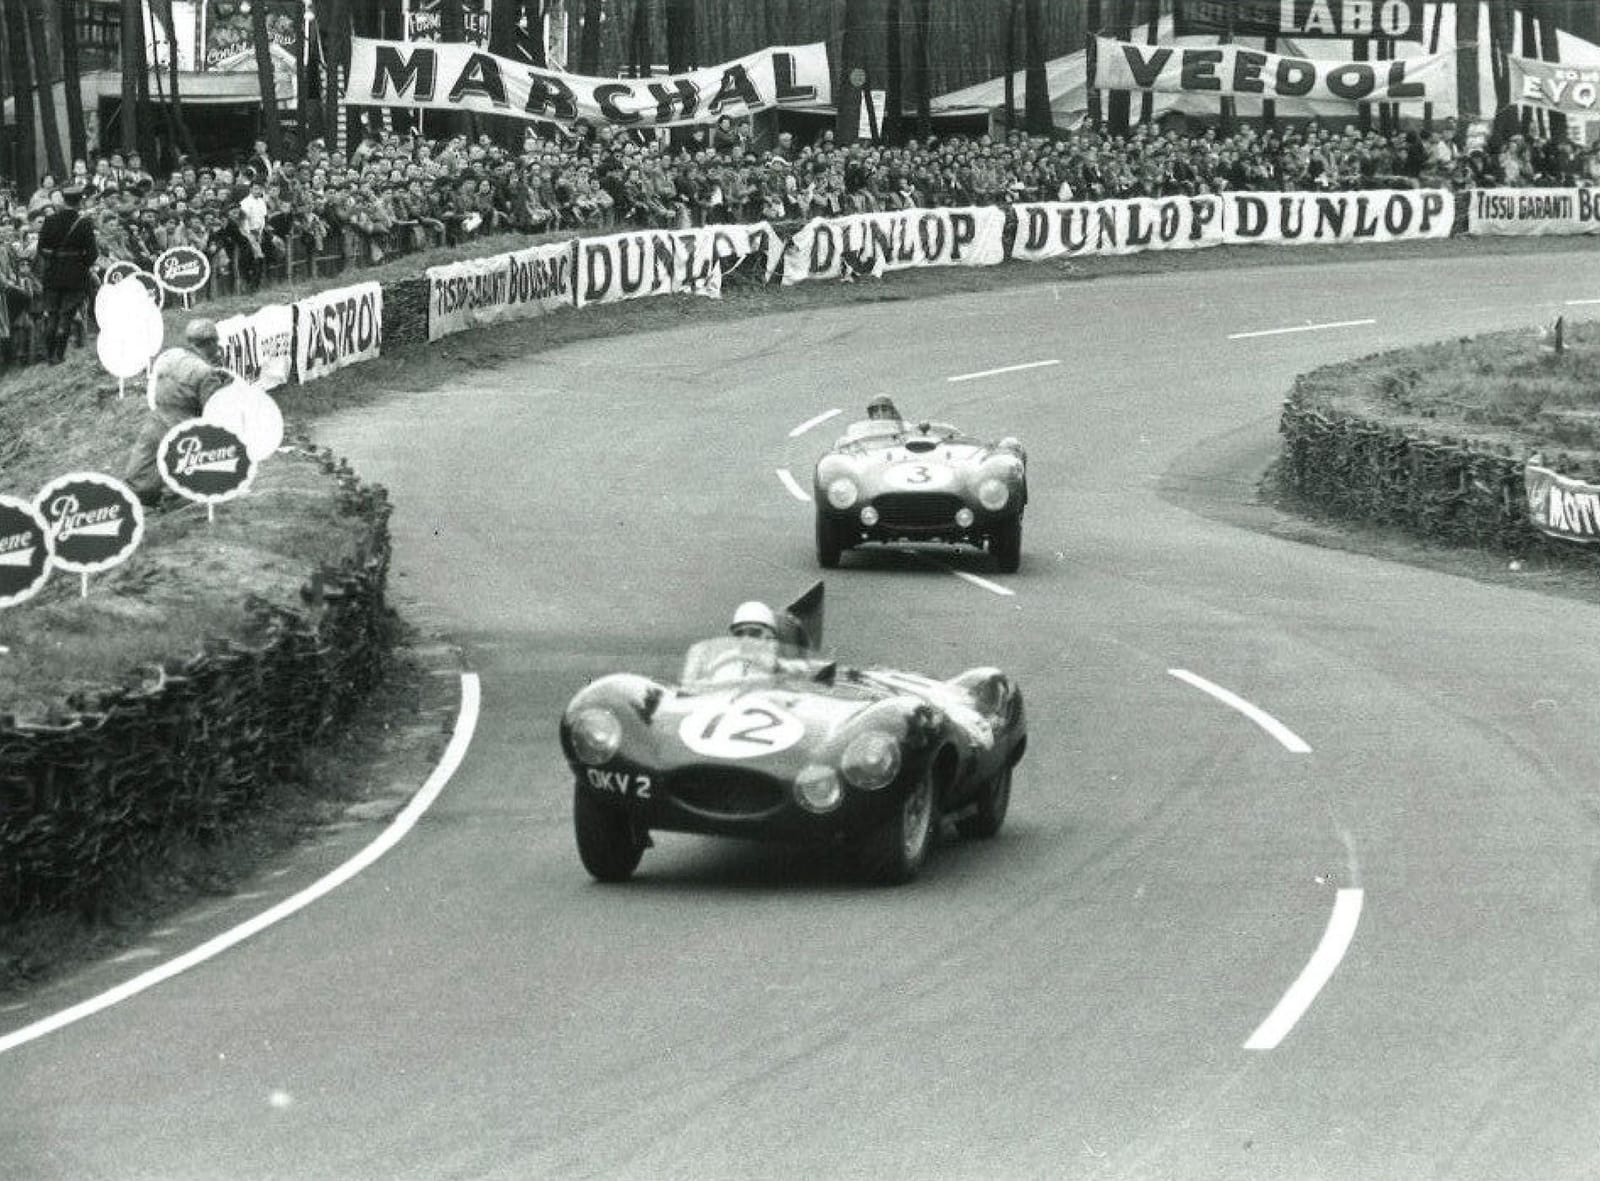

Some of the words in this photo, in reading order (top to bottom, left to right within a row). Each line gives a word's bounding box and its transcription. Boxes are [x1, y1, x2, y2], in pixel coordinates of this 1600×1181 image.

[1279, 0, 1411, 36] LABO
[371, 45, 816, 124] MARCHAL
[1122, 45, 1426, 99] VEEDOL
[1024, 199, 1216, 250] DUNLOP
[1235, 193, 1444, 238] DUNLOP
[1477, 190, 1516, 220] TISSU
[809, 212, 976, 276] DUNLOP
[175, 436, 237, 476] Pyrene
[906, 465, 932, 485] 3
[50, 494, 121, 542] Pyrene
[700, 707, 784, 746] 12
[635, 774, 652, 799] 2
